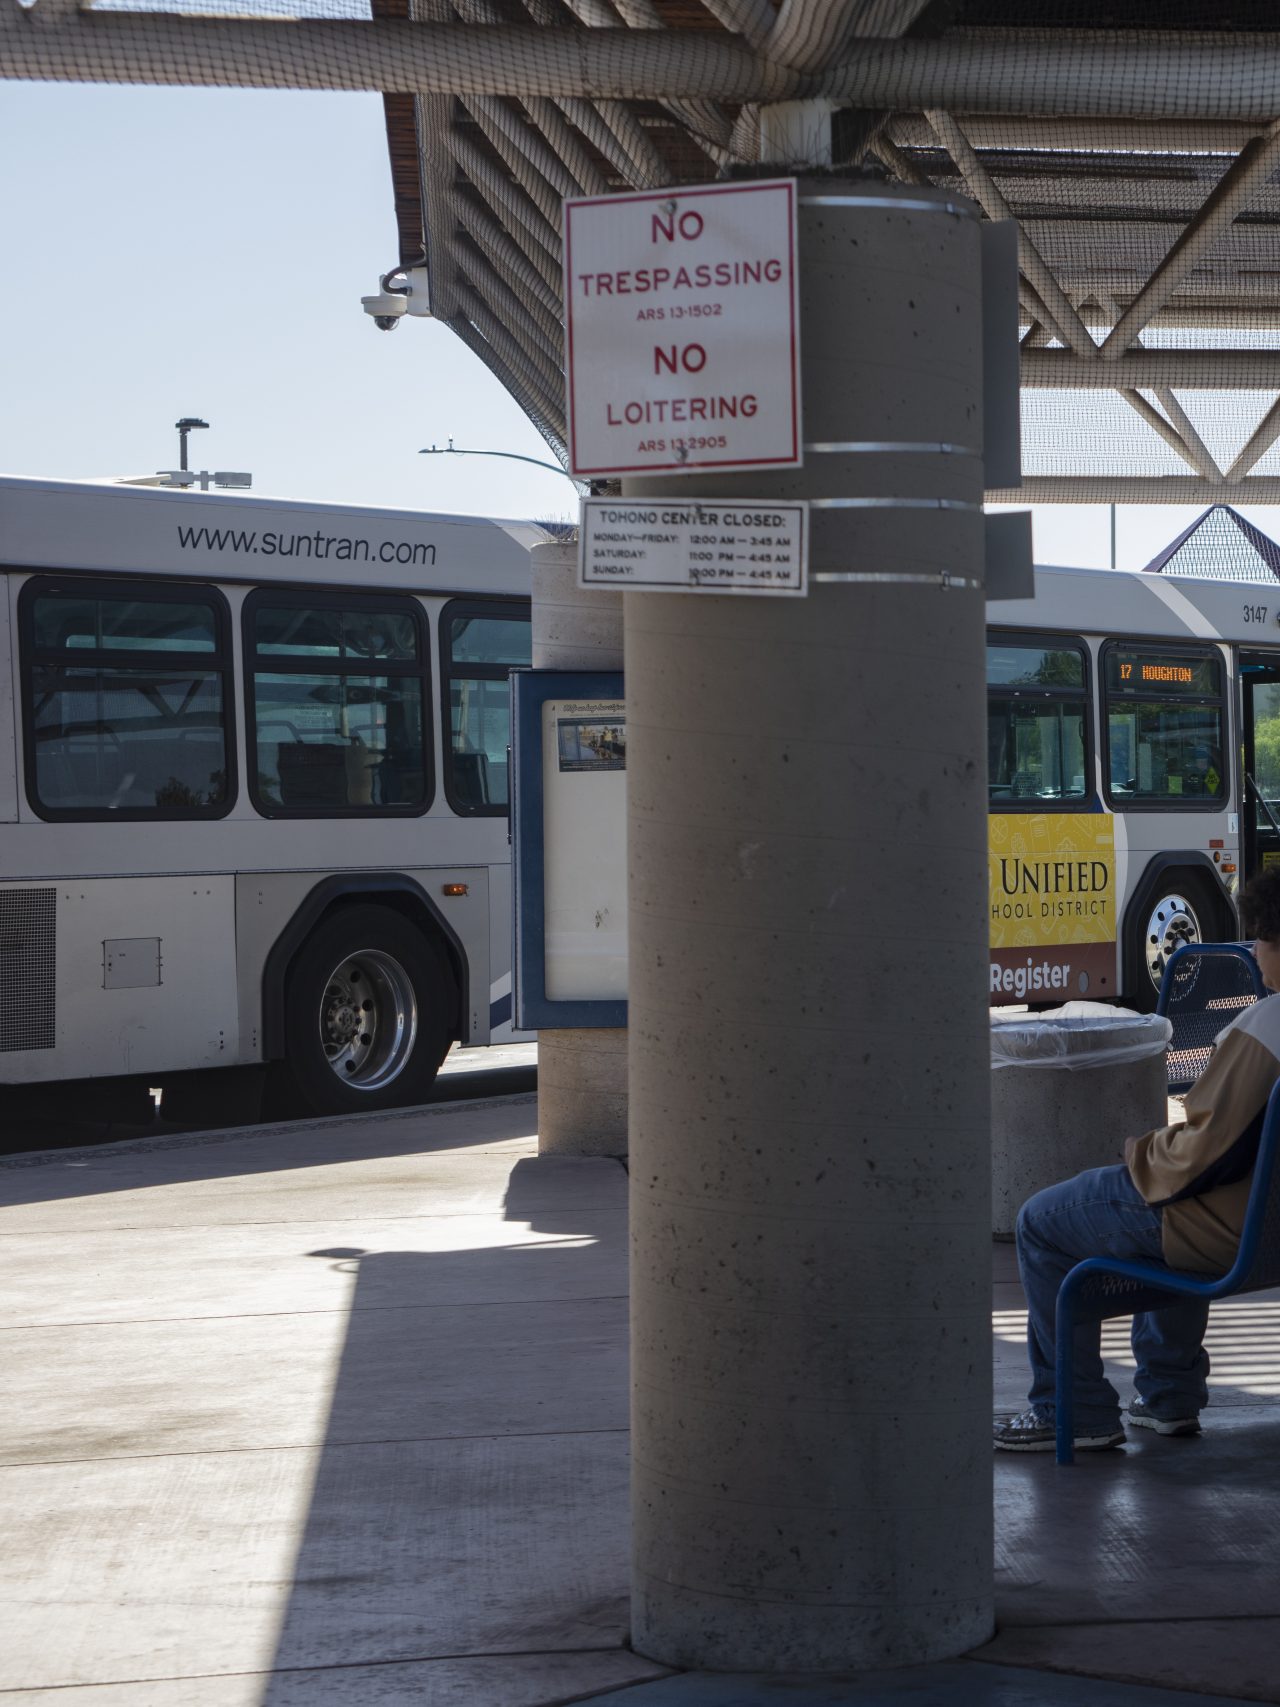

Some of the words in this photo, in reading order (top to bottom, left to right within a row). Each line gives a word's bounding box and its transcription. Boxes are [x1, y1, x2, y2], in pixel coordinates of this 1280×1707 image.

[652, 211, 704, 243] NO
[578, 259, 782, 296] TRESPASSING
[636, 307, 665, 321] ARS
[669, 304, 722, 319] 13-1502
[654, 343, 707, 375] NO
[607, 394, 758, 426] LOITERING
[638, 440, 665, 452] ARS
[600, 510, 658, 525] TOHONO
[661, 511, 718, 526] CENTER
[723, 513, 786, 528] CLOSED:
[177, 525, 437, 566] www.suntran.com
[689, 535, 717, 545] 12:00
[719, 536, 735, 545] AM
[775, 538, 791, 547] AM
[593, 549, 647, 559] SATURDAY:
[689, 552, 713, 561] 11:00
[718, 552, 734, 561] PM
[774, 554, 790, 563] AM
[592, 565, 634, 575] SUNDAY:
[718, 569, 734, 578] PM
[775, 571, 791, 580] AM
[1243, 605, 1268, 624] 3147
[1120, 664, 1132, 680] 17
[1142, 665, 1192, 682] HOUGHTON
[1000, 858, 1108, 895] UNIFIED
[992, 903, 1033, 919] HOOL
[1041, 900, 1107, 918] DISTRICT
[989, 957, 1070, 998] Register
